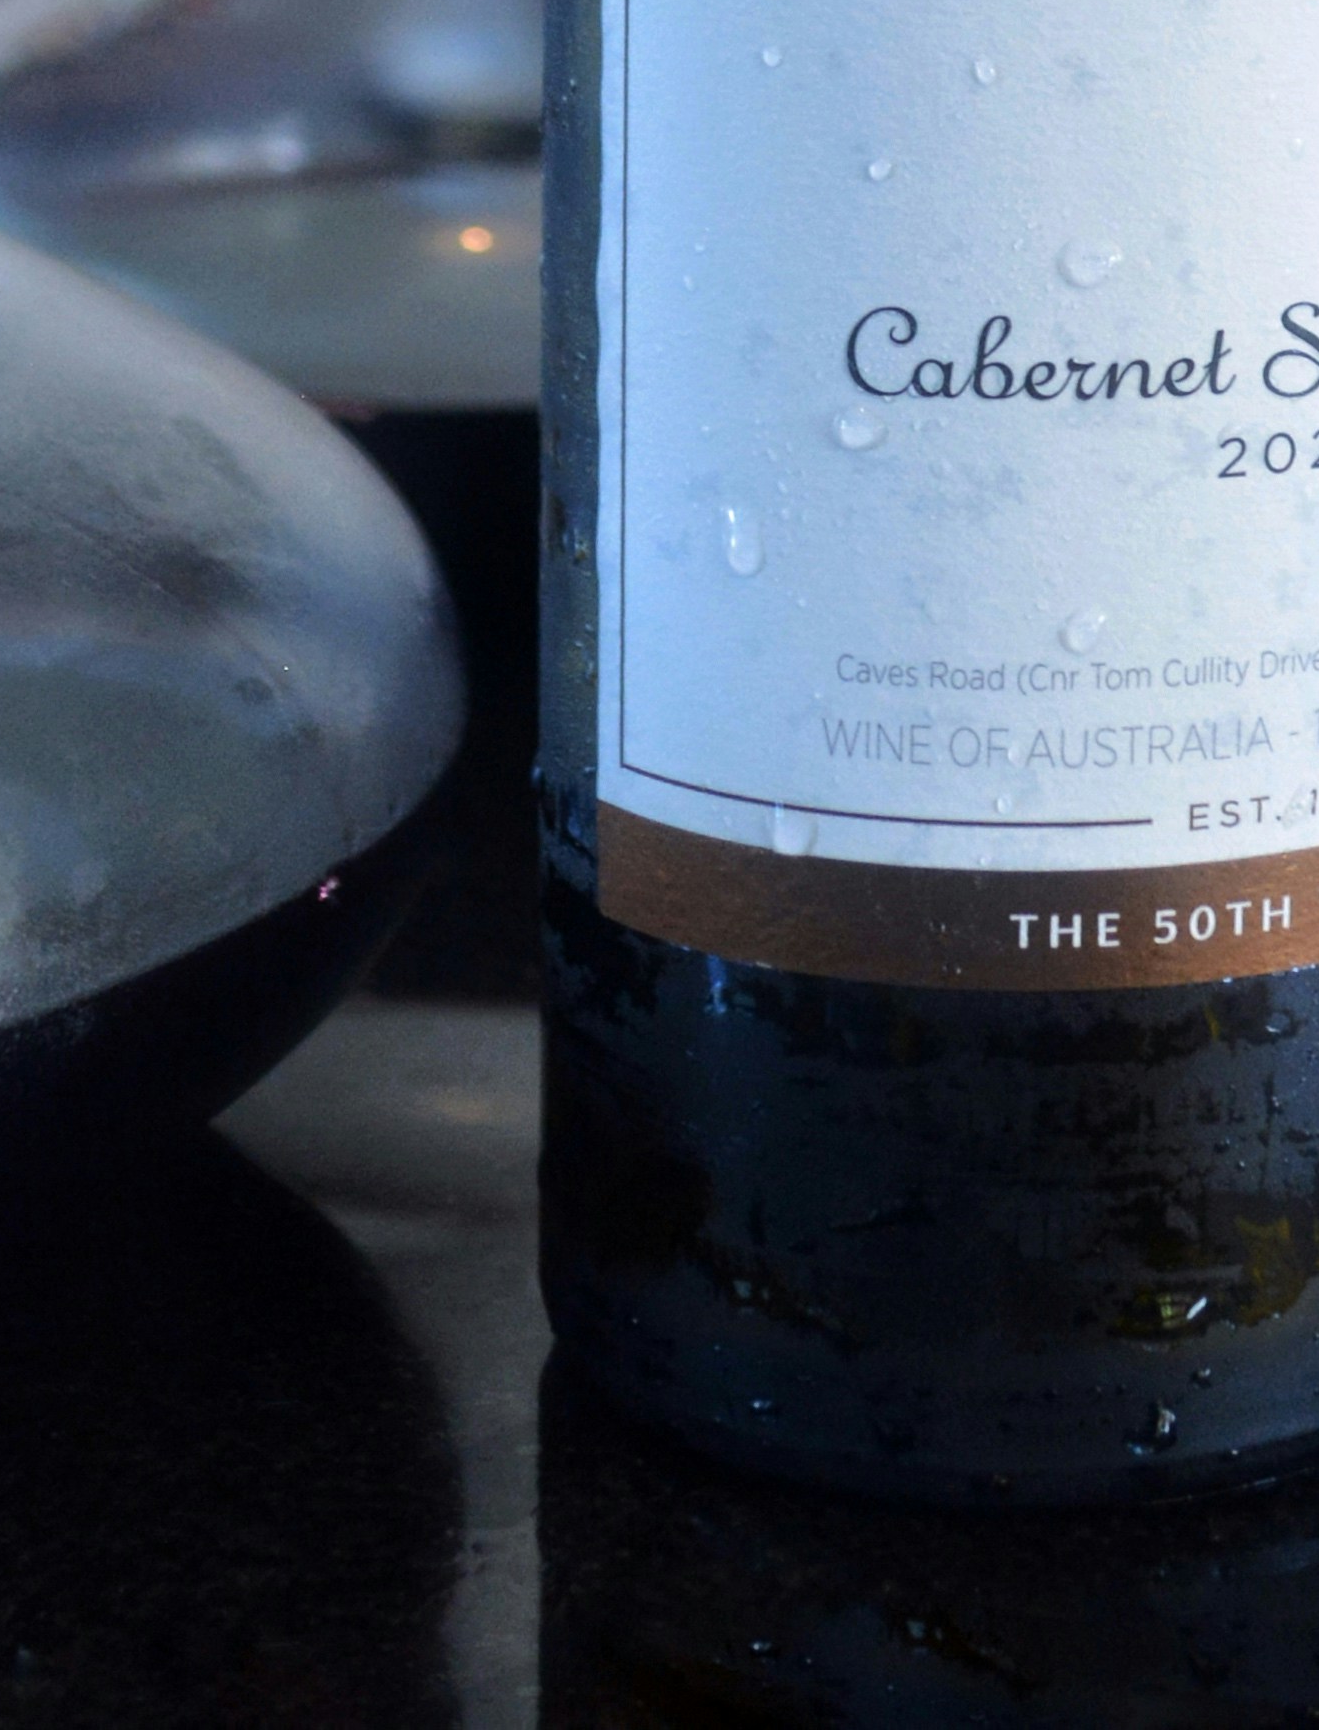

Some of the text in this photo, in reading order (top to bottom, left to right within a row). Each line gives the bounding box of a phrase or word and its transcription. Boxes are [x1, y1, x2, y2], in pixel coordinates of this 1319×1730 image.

[846, 306, 1237, 401] Cabernet
[836, 653, 919, 688] Caves
[929, 661, 1006, 690] Road
[1017, 662, 1080, 696] (Cnr
[1090, 662, 1152, 690] Tom
[1162, 656, 1250, 687] Cullity
[822, 718, 932, 766] WINE
[948, 726, 1010, 768] OF
[1025, 716, 1274, 769] AUSTRALIA
[1188, 795, 1282, 832] EST.
[1010, 913, 1121, 950] THE
[1153, 898, 1292, 945] 50TH
